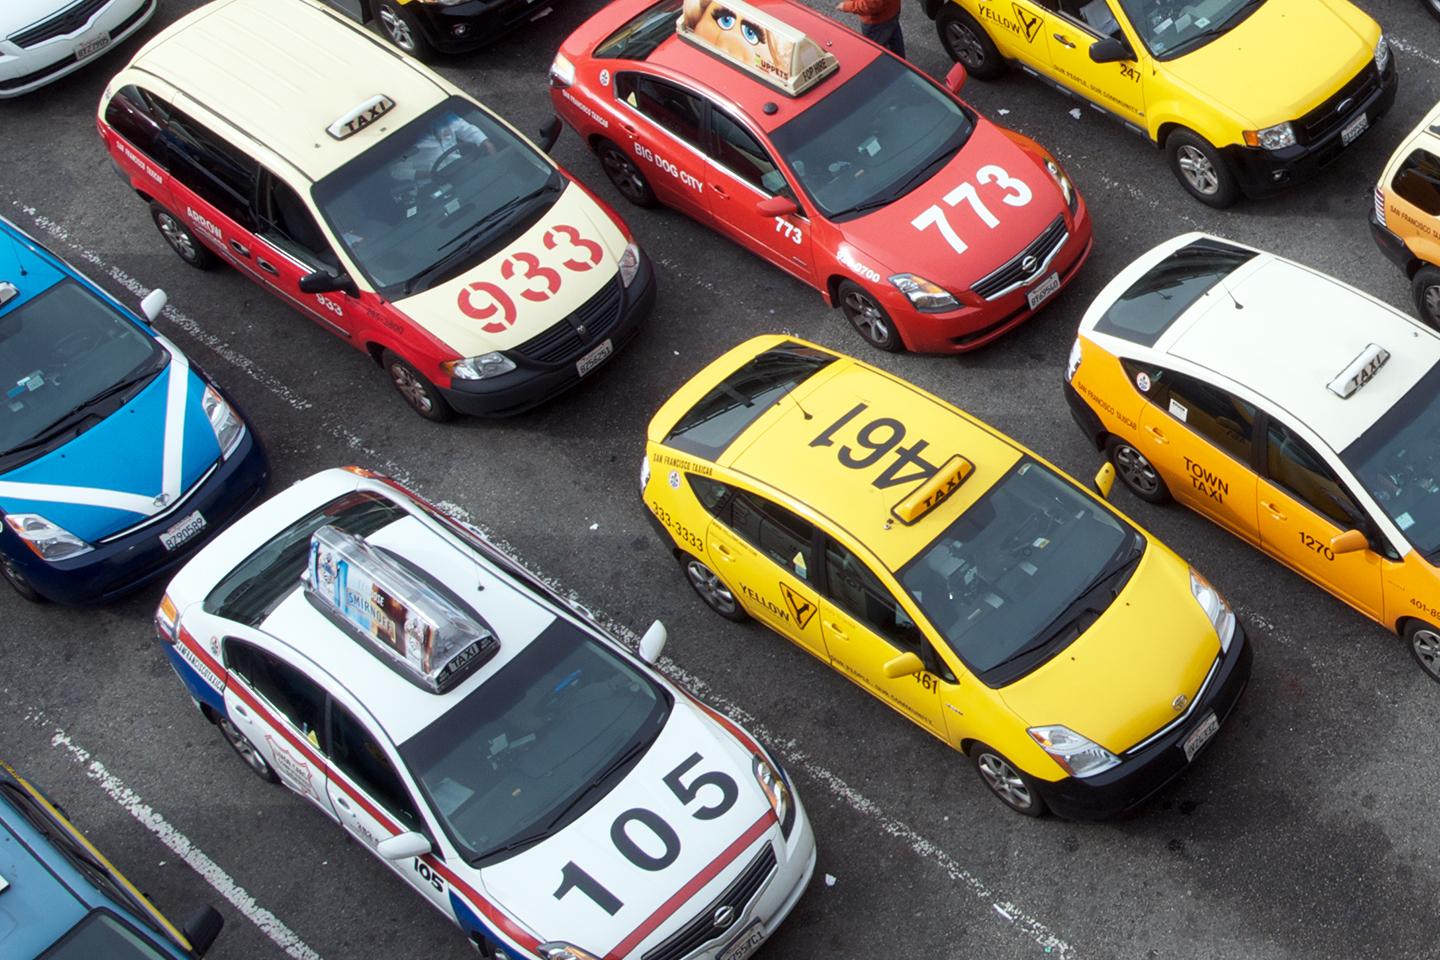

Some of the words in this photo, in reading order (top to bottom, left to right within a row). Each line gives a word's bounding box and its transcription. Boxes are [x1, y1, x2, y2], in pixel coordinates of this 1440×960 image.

[978, 3, 1020, 34] YELLOW
[1119, 63, 1142, 83] 247
[345, 101, 386, 132] TAXI
[634, 142, 654, 163] BIG
[655, 154, 679, 179] DOG
[680, 170, 704, 193] CITY
[911, 164, 1033, 255] 773
[1390, 204, 1401, 218] SAN
[1401, 211, 1431, 235] FRANCISCO
[775, 215, 803, 245] 773
[457, 224, 604, 334] 933
[836, 249, 881, 283] 90700
[315, 292, 343, 317] 933
[1351, 353, 1381, 387] TAXI
[808, 402, 939, 490] 461
[653, 453, 663, 463] SAN
[664, 456, 691, 471] FRANCISCO
[692, 463, 713, 476] TAXICAB
[1184, 456, 1229, 496] TOWN
[923, 471, 963, 508] TAXI
[1190, 474, 1223, 505] TAXI
[652, 501, 704, 552] 333-3333
[1298, 531, 1335, 561] 1270
[348, 592, 394, 632] SMIRNOFF
[739, 581, 790, 622] YELLOW
[451, 646, 477, 668] TAXI
[912, 671, 938, 695] 461
[552, 751, 739, 917] 105
[414, 856, 444, 893] 105
